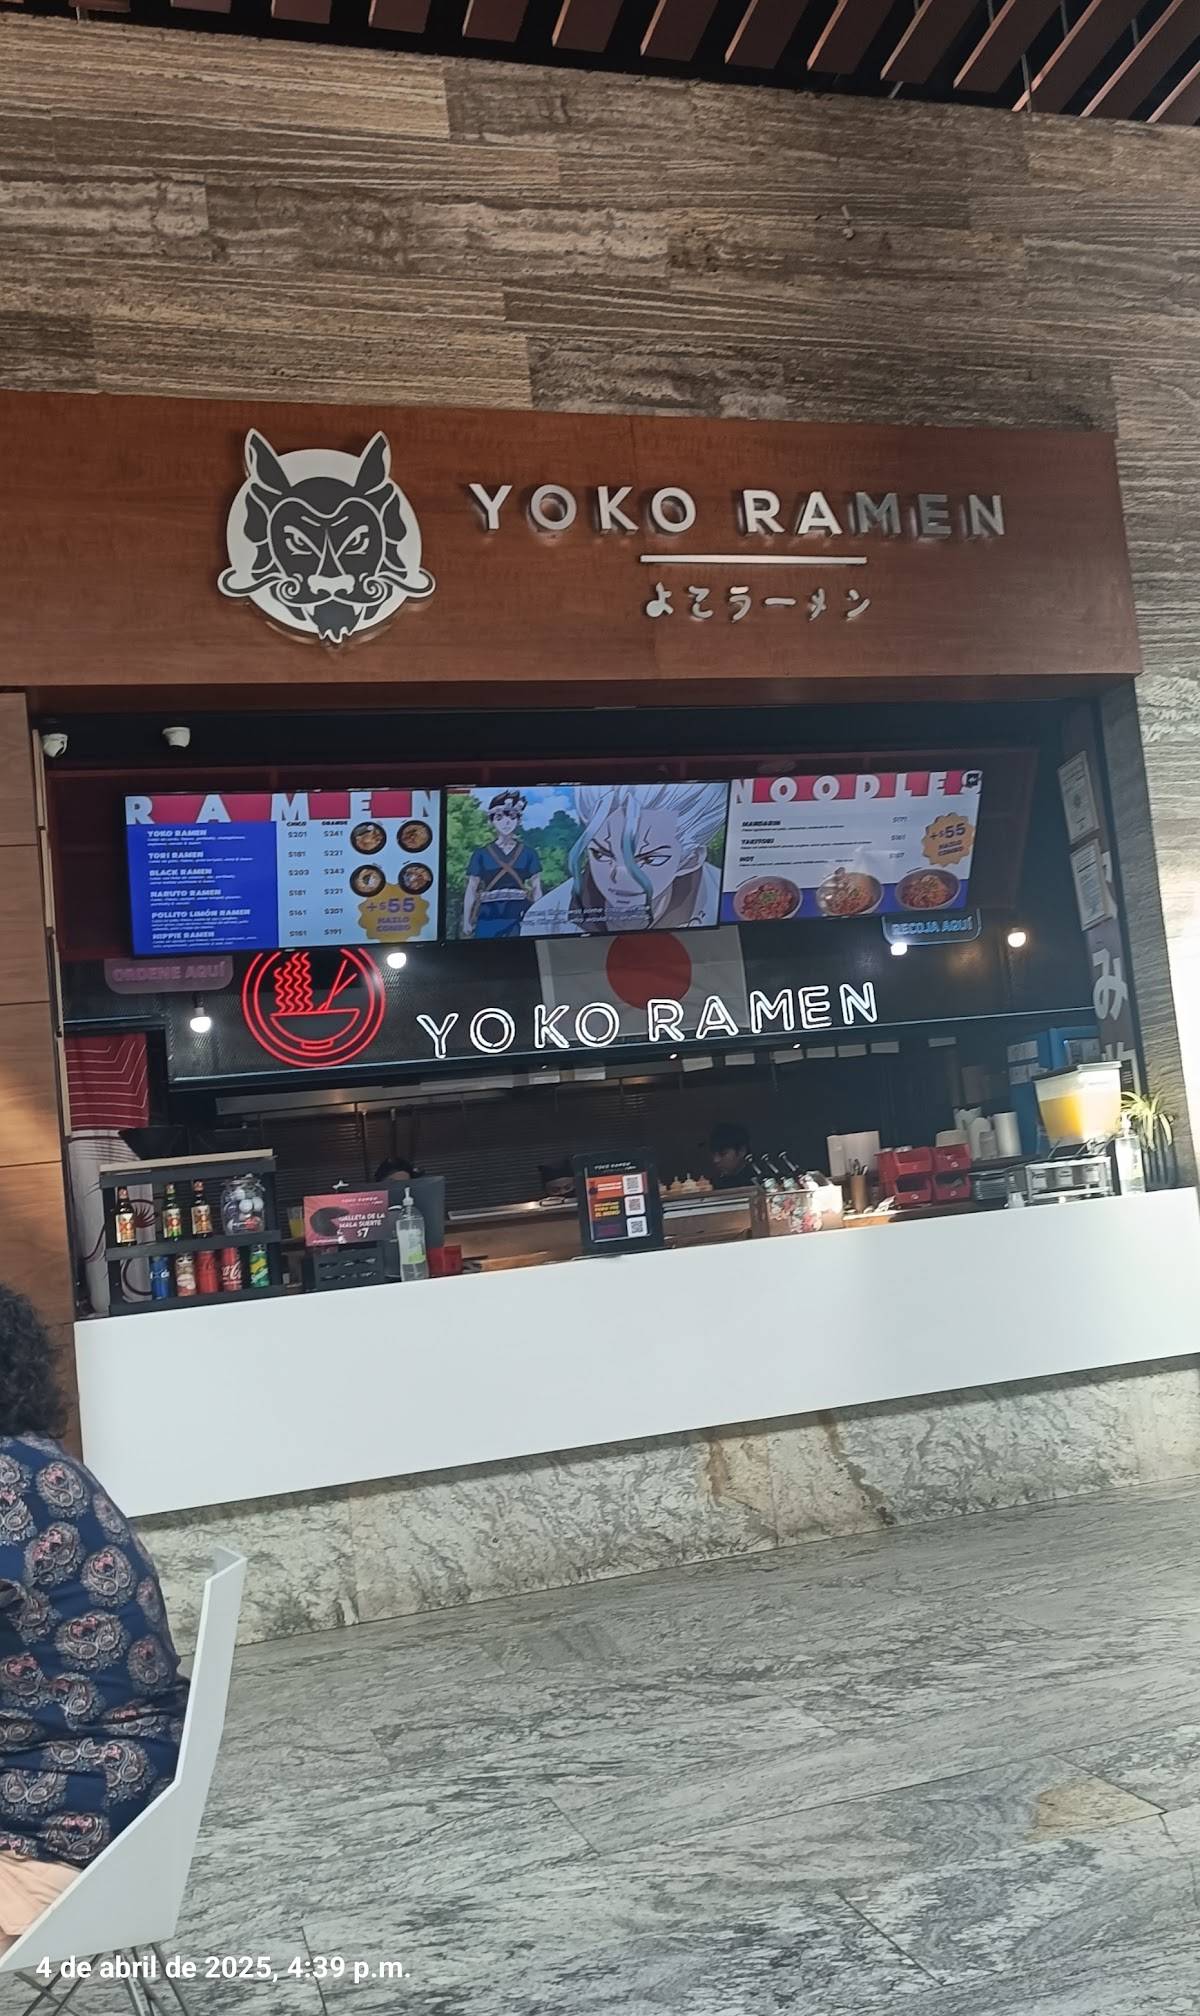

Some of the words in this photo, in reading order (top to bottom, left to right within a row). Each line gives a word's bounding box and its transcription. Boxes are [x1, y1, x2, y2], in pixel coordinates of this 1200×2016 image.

[469, 483, 697, 535] YOKO
[741, 488, 1006, 539] RAMEN
[730, 770, 983, 804] NOODLES
[125, 790, 440, 825] RAMEN
[171, 851, 204, 859] RAMEN
[180, 868, 212, 876] RAMEN
[189, 889, 222, 897] RAMEN
[152, 911, 188, 919] POLLITO
[183, 931, 215, 939] RAMEN
[416, 1001, 621, 1059] YOKO
[647, 981, 878, 1042] RAMEN
